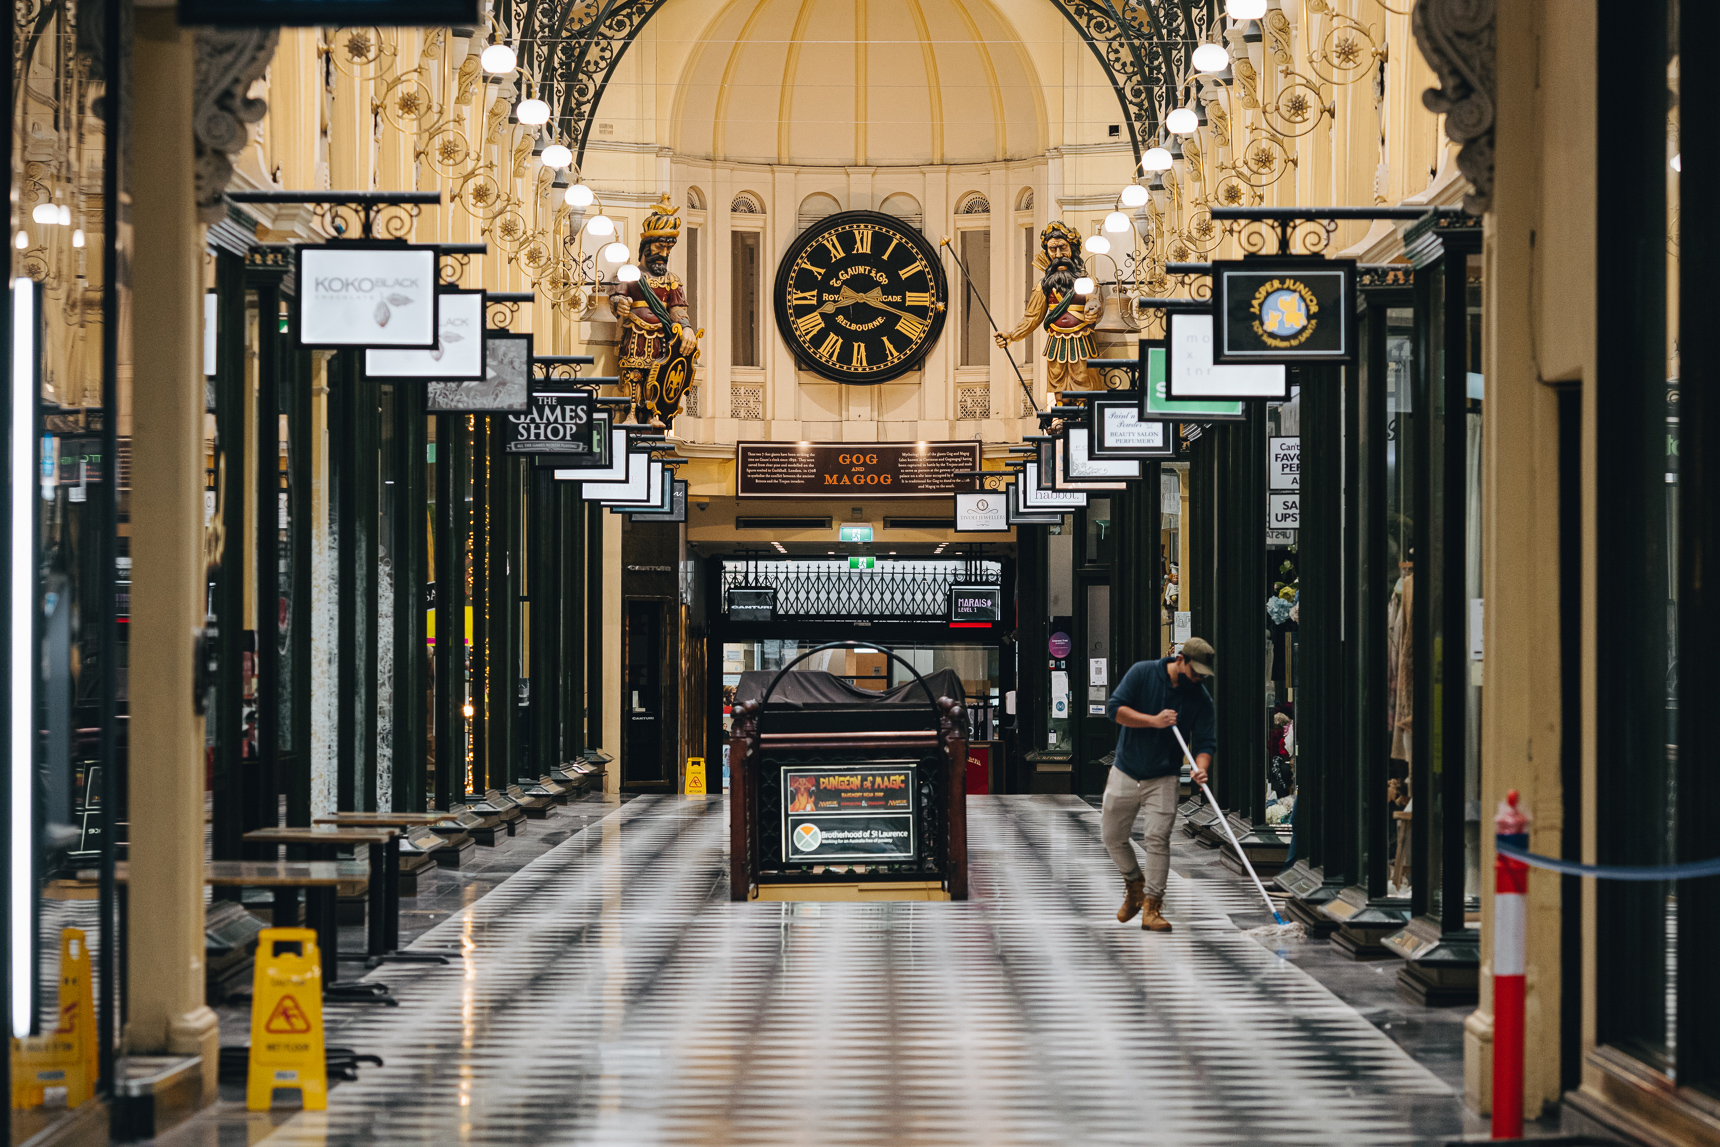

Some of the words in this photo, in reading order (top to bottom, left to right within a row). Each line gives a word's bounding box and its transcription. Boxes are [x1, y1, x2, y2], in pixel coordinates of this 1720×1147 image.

[822, 235, 846, 262] XI
[852, 230, 873, 254] XII
[882, 238, 899, 260] I
[801, 258, 826, 280] X
[898, 260, 923, 280] II
[315, 277, 374, 293] KOKO
[374, 278, 420, 288] BLACK
[793, 289, 817, 305] IX
[906, 292, 930, 306] III
[1250, 279, 1282, 315] JASPER
[1283, 278, 1319, 315] JUNIOR
[438, 318, 468, 326] ACK
[797, 312, 825, 342] VIII
[818, 332, 843, 362] VII
[852, 342, 868, 366] VI
[881, 336, 899, 360] V
[518, 424, 576, 440] SHOP
[838, 453, 878, 464] GOG
[824, 474, 893, 485] MAGOG
[1275, 513, 1300, 522] UPS
[958, 598, 987, 607] MARAIS
[820, 776, 861, 790] DUNGEON
[874, 775, 905, 789] MAGIC
